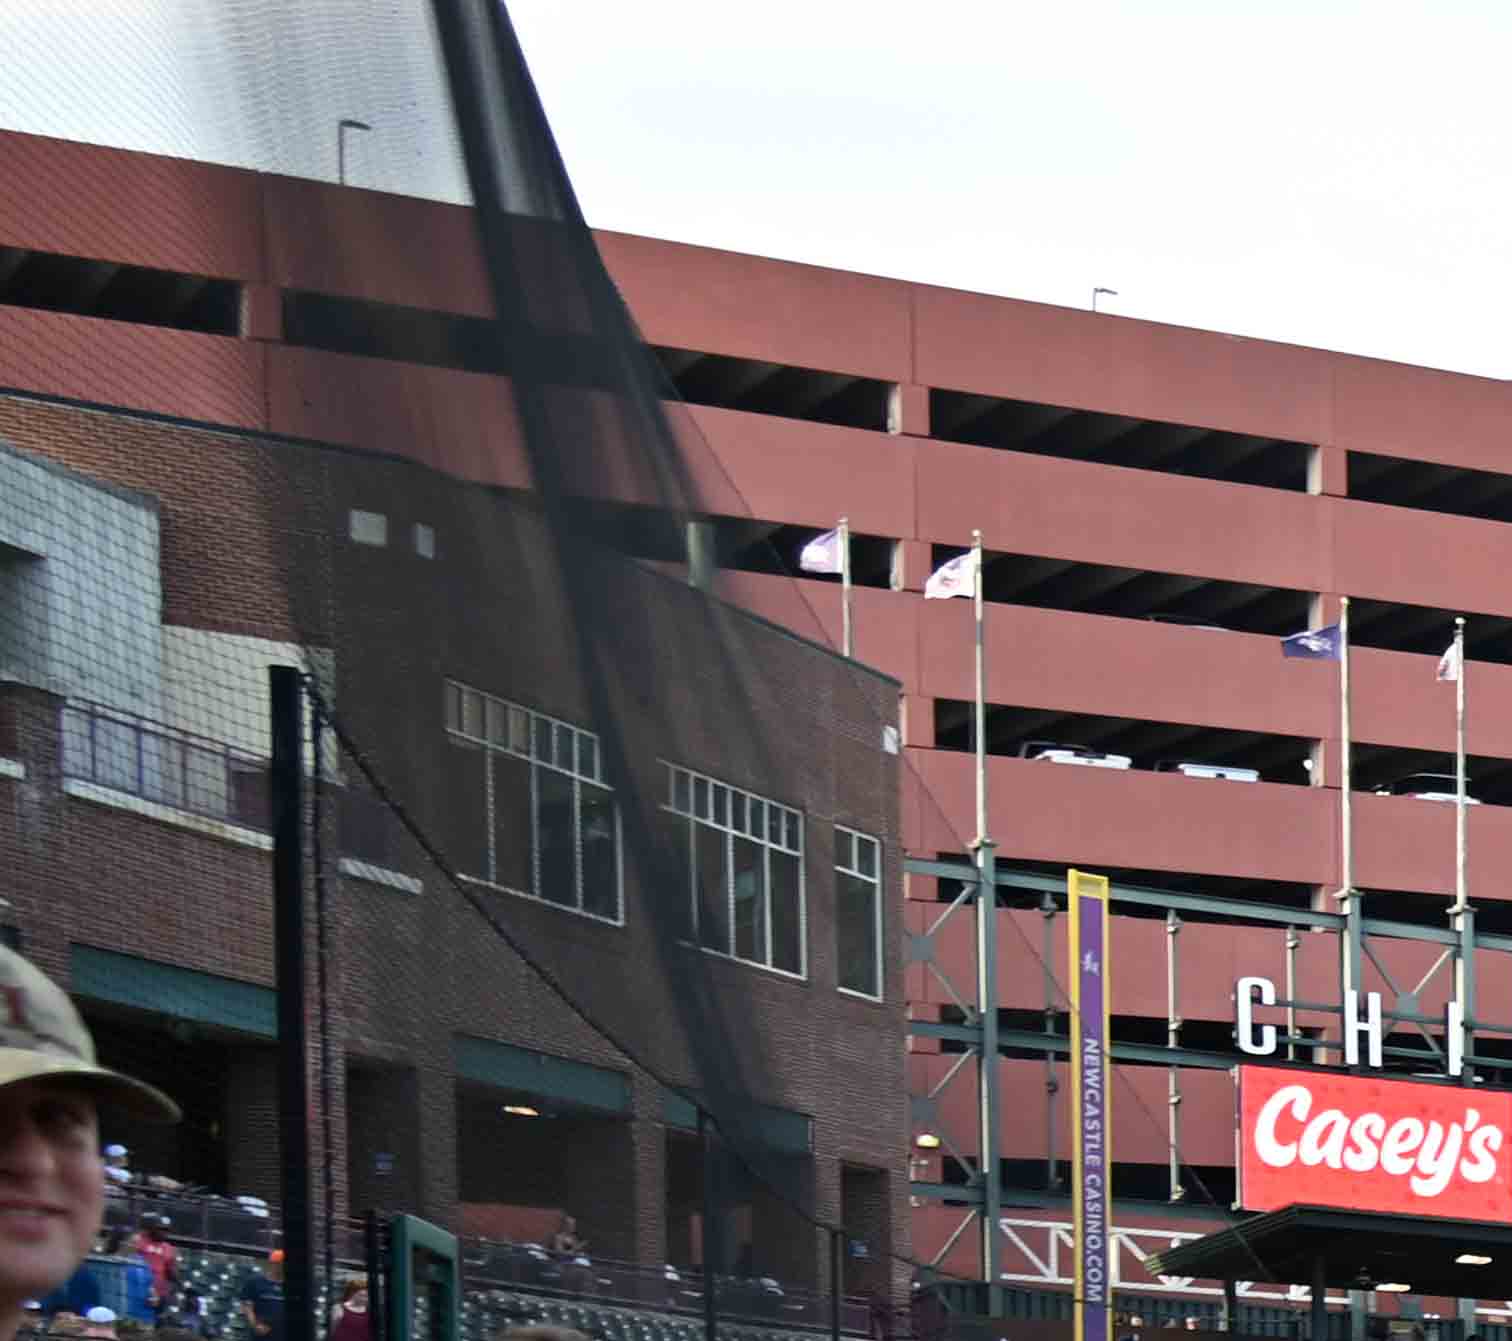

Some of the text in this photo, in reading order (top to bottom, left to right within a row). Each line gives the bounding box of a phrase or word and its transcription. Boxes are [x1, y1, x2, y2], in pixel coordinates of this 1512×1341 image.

[1083, 1038, 1104, 1302] NEWCASTLE CASINO.COM
[1254, 1084, 1502, 1198] Casey's
